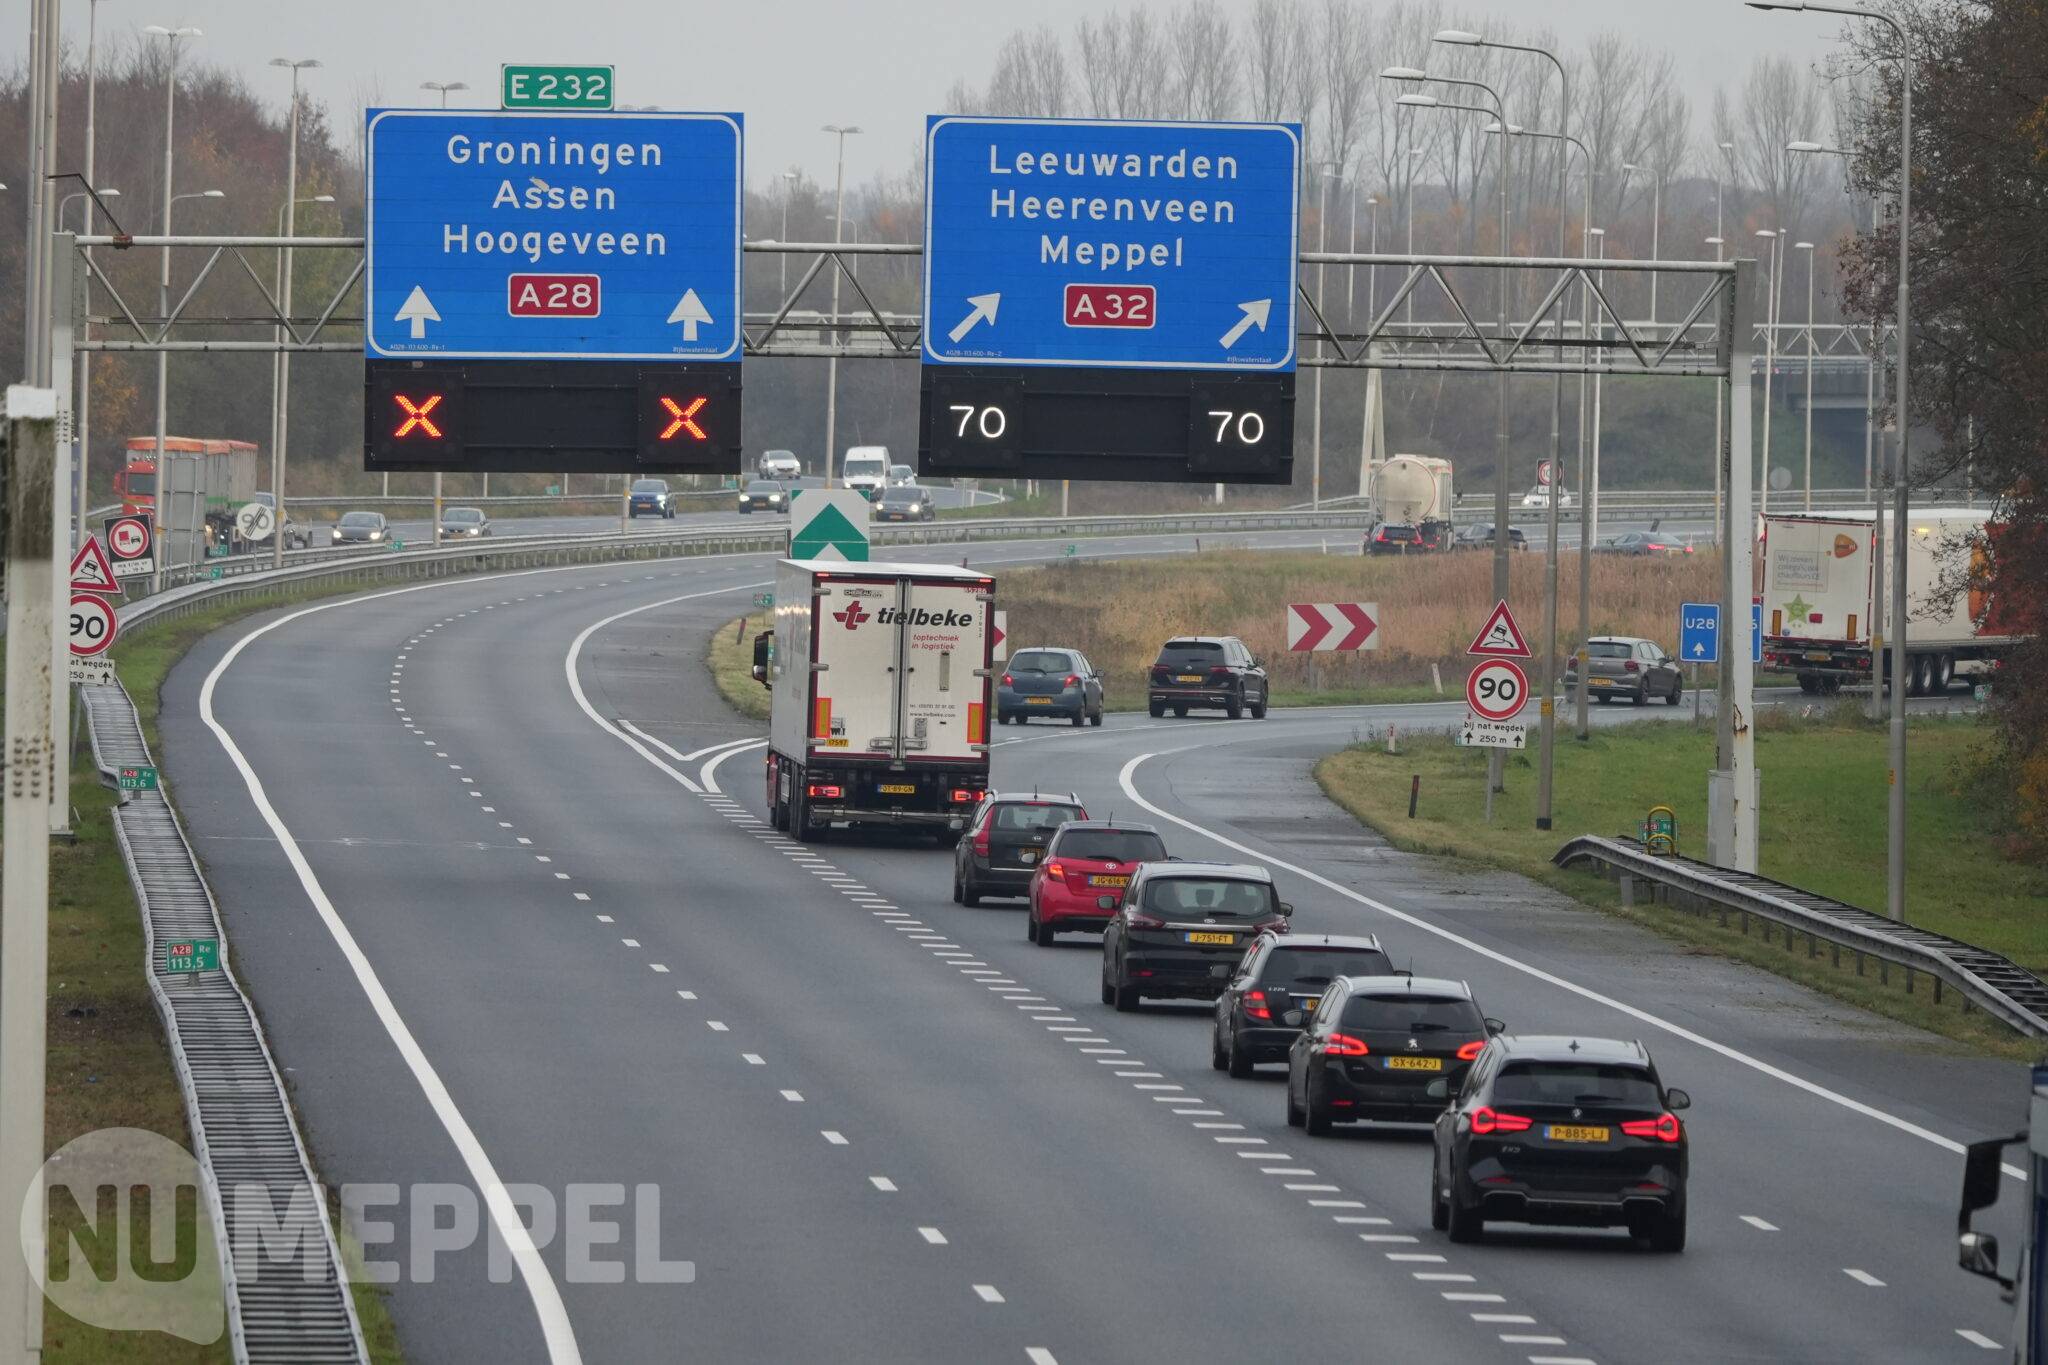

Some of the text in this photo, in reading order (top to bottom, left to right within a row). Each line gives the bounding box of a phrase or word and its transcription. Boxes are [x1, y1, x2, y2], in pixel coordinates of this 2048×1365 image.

[447, 134, 662, 175] Groningen
[989, 145, 1238, 179] Leeuwarden
[492, 179, 616, 210] Assen
[990, 189, 1235, 223] Heerenveen
[443, 223, 666, 263] Hoogeveen
[1040, 234, 1183, 271] Meppel
[949, 405, 1006, 439] 70
[1208, 411, 1265, 444] 70
[877, 607, 973, 627] tielbeke
[1685, 617, 1715, 630] U28
[69, 613, 105, 639] 90
[912, 633, 960, 643] toptechniek
[921, 641, 956, 651] logistiek
[70, 658, 113, 670] at wegdek
[1478, 677, 1516, 701] 90
[1463, 721, 1525, 734] bij nat wegdek
[1479, 734, 1507, 744] 250 m
[122, 769, 151, 778] A28 Re
[1194, 934, 1229, 943] J-751-FT
[172, 944, 211, 955] A28 Re
[1392, 1058, 1438, 1069] SX-642-J
[1554, 1127, 1605, 1140] P-885-LJ
